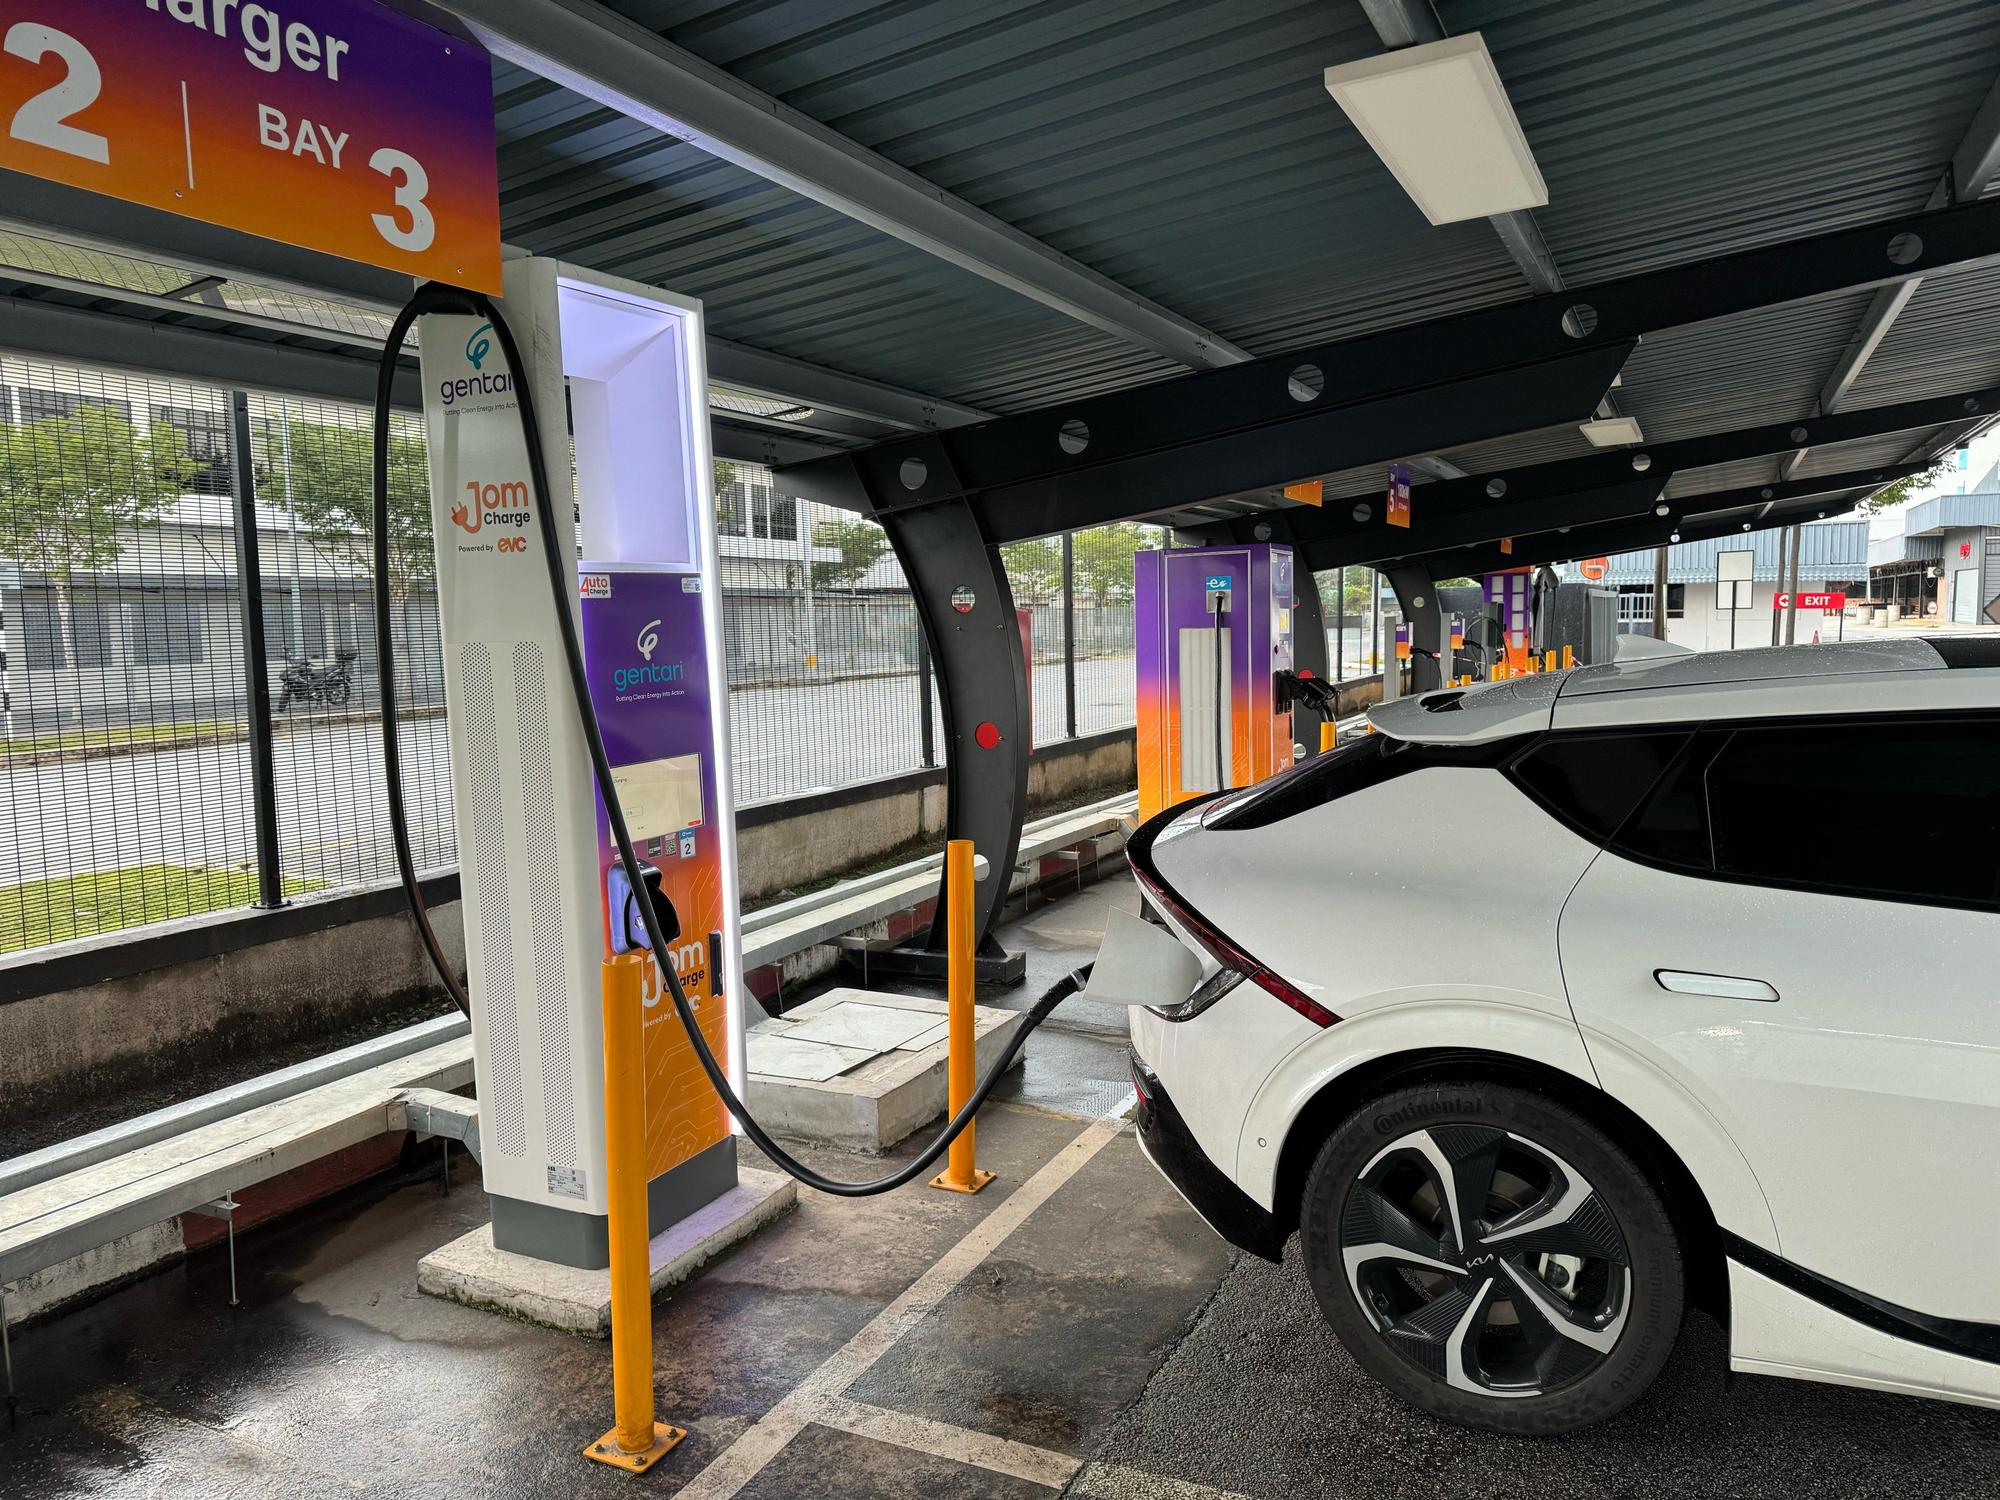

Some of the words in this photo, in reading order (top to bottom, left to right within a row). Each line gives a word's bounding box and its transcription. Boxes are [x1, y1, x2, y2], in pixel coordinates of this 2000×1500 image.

[146, 0, 350, 82] arger
[3, 21, 111, 165] 2
[258, 103, 350, 169] BAY
[368, 147, 436, 253] 3
[441, 372, 512, 405] gentar
[477, 405, 494, 413] Energy
[454, 481, 529, 534] Jom
[1389, 488, 1395, 513] 5
[484, 512, 531, 527] Charge
[458, 544, 484, 552] Powered
[485, 543, 493, 552] by
[589, 588, 609, 596] Charge
[1804, 596, 1831, 606] EXIT
[614, 661, 684, 692] gentari
[633, 693, 646, 701] Clean
[646, 692, 661, 700] Energy
[684, 842, 691, 855] 2
[663, 969, 705, 993] arge
[1373, 1098, 1482, 1136] Continental
